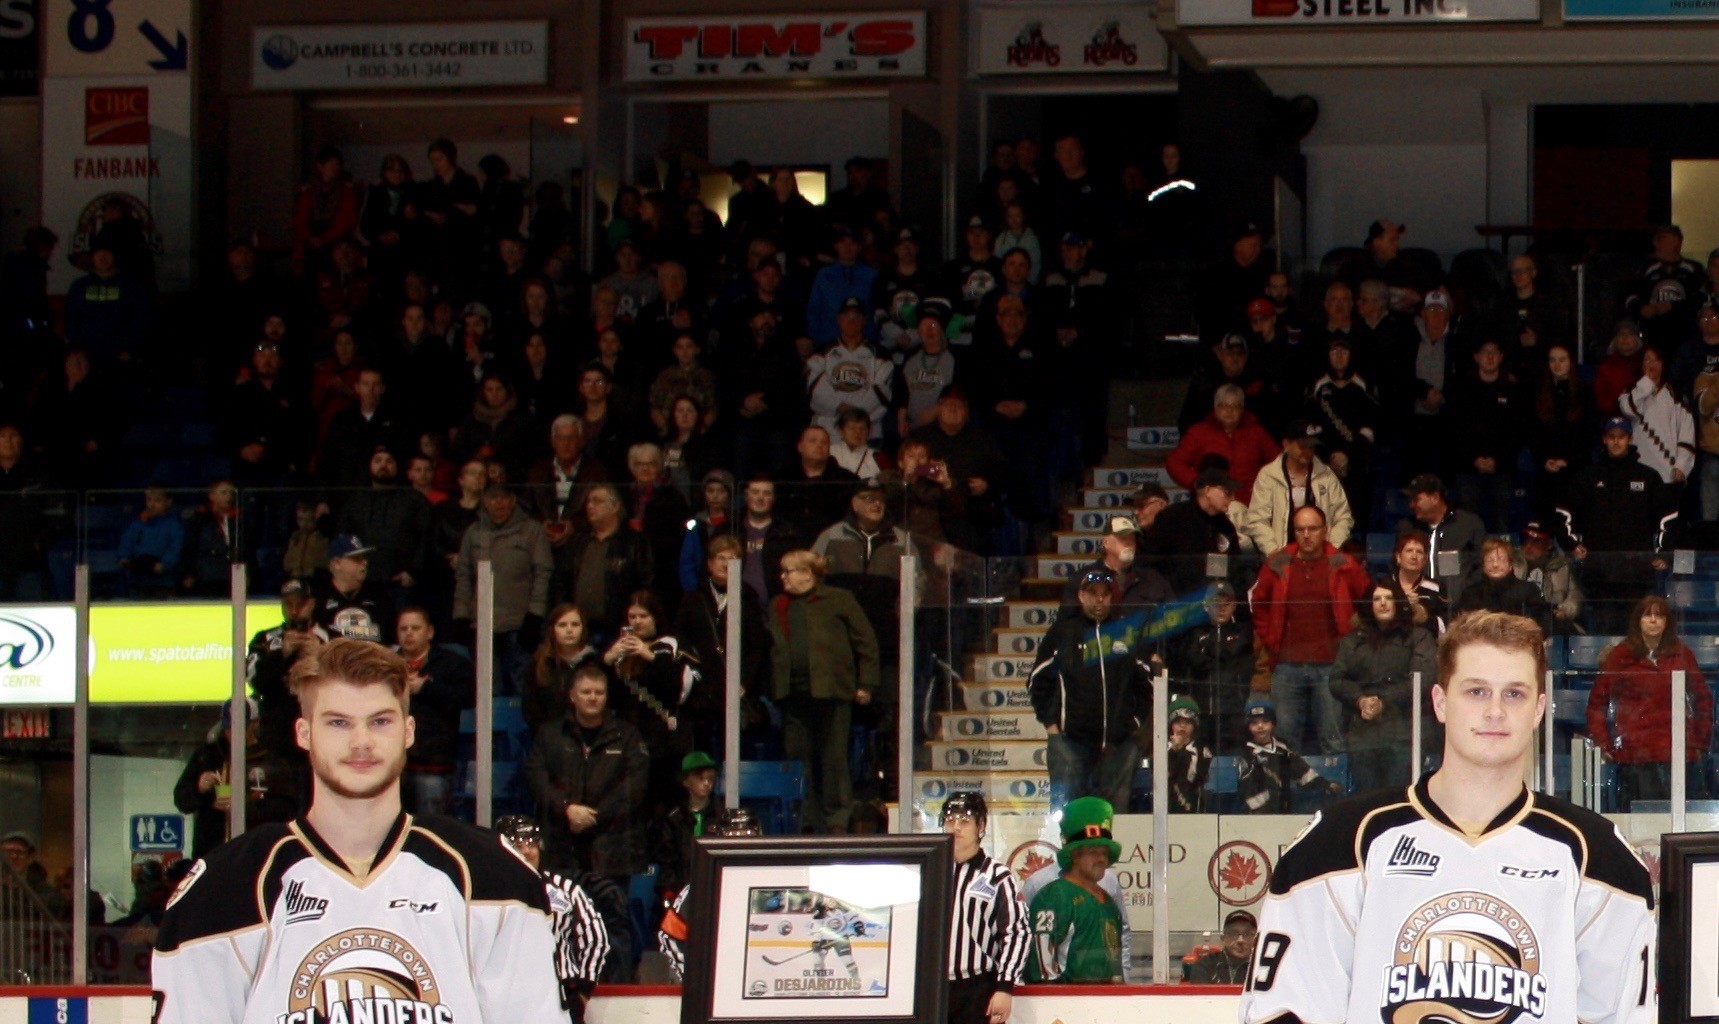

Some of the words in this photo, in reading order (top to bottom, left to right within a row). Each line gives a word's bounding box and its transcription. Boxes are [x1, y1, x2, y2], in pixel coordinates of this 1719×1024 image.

[301, 44, 403, 59] CAMPBELL'S
[408, 41, 498, 58] CONCRETE
[636, 21, 914, 59] TIM'S
[650, 59, 900, 76] CRANES
[89, 93, 147, 115] CIBC
[74, 157, 160, 179] FANBANK
[7, 711, 48, 738] EXIT
[986, 718, 1018, 727] United
[1500, 866, 1560, 881] CCM
[1036, 911, 1055, 929] 23
[1399, 896, 1537, 962] CHARLOTTETOWN
[294, 932, 434, 1000] CHARLOTTETOWN
[773, 978, 862, 992] DESJARDINS
[1381, 961, 1548, 1020] ISLANDERS
